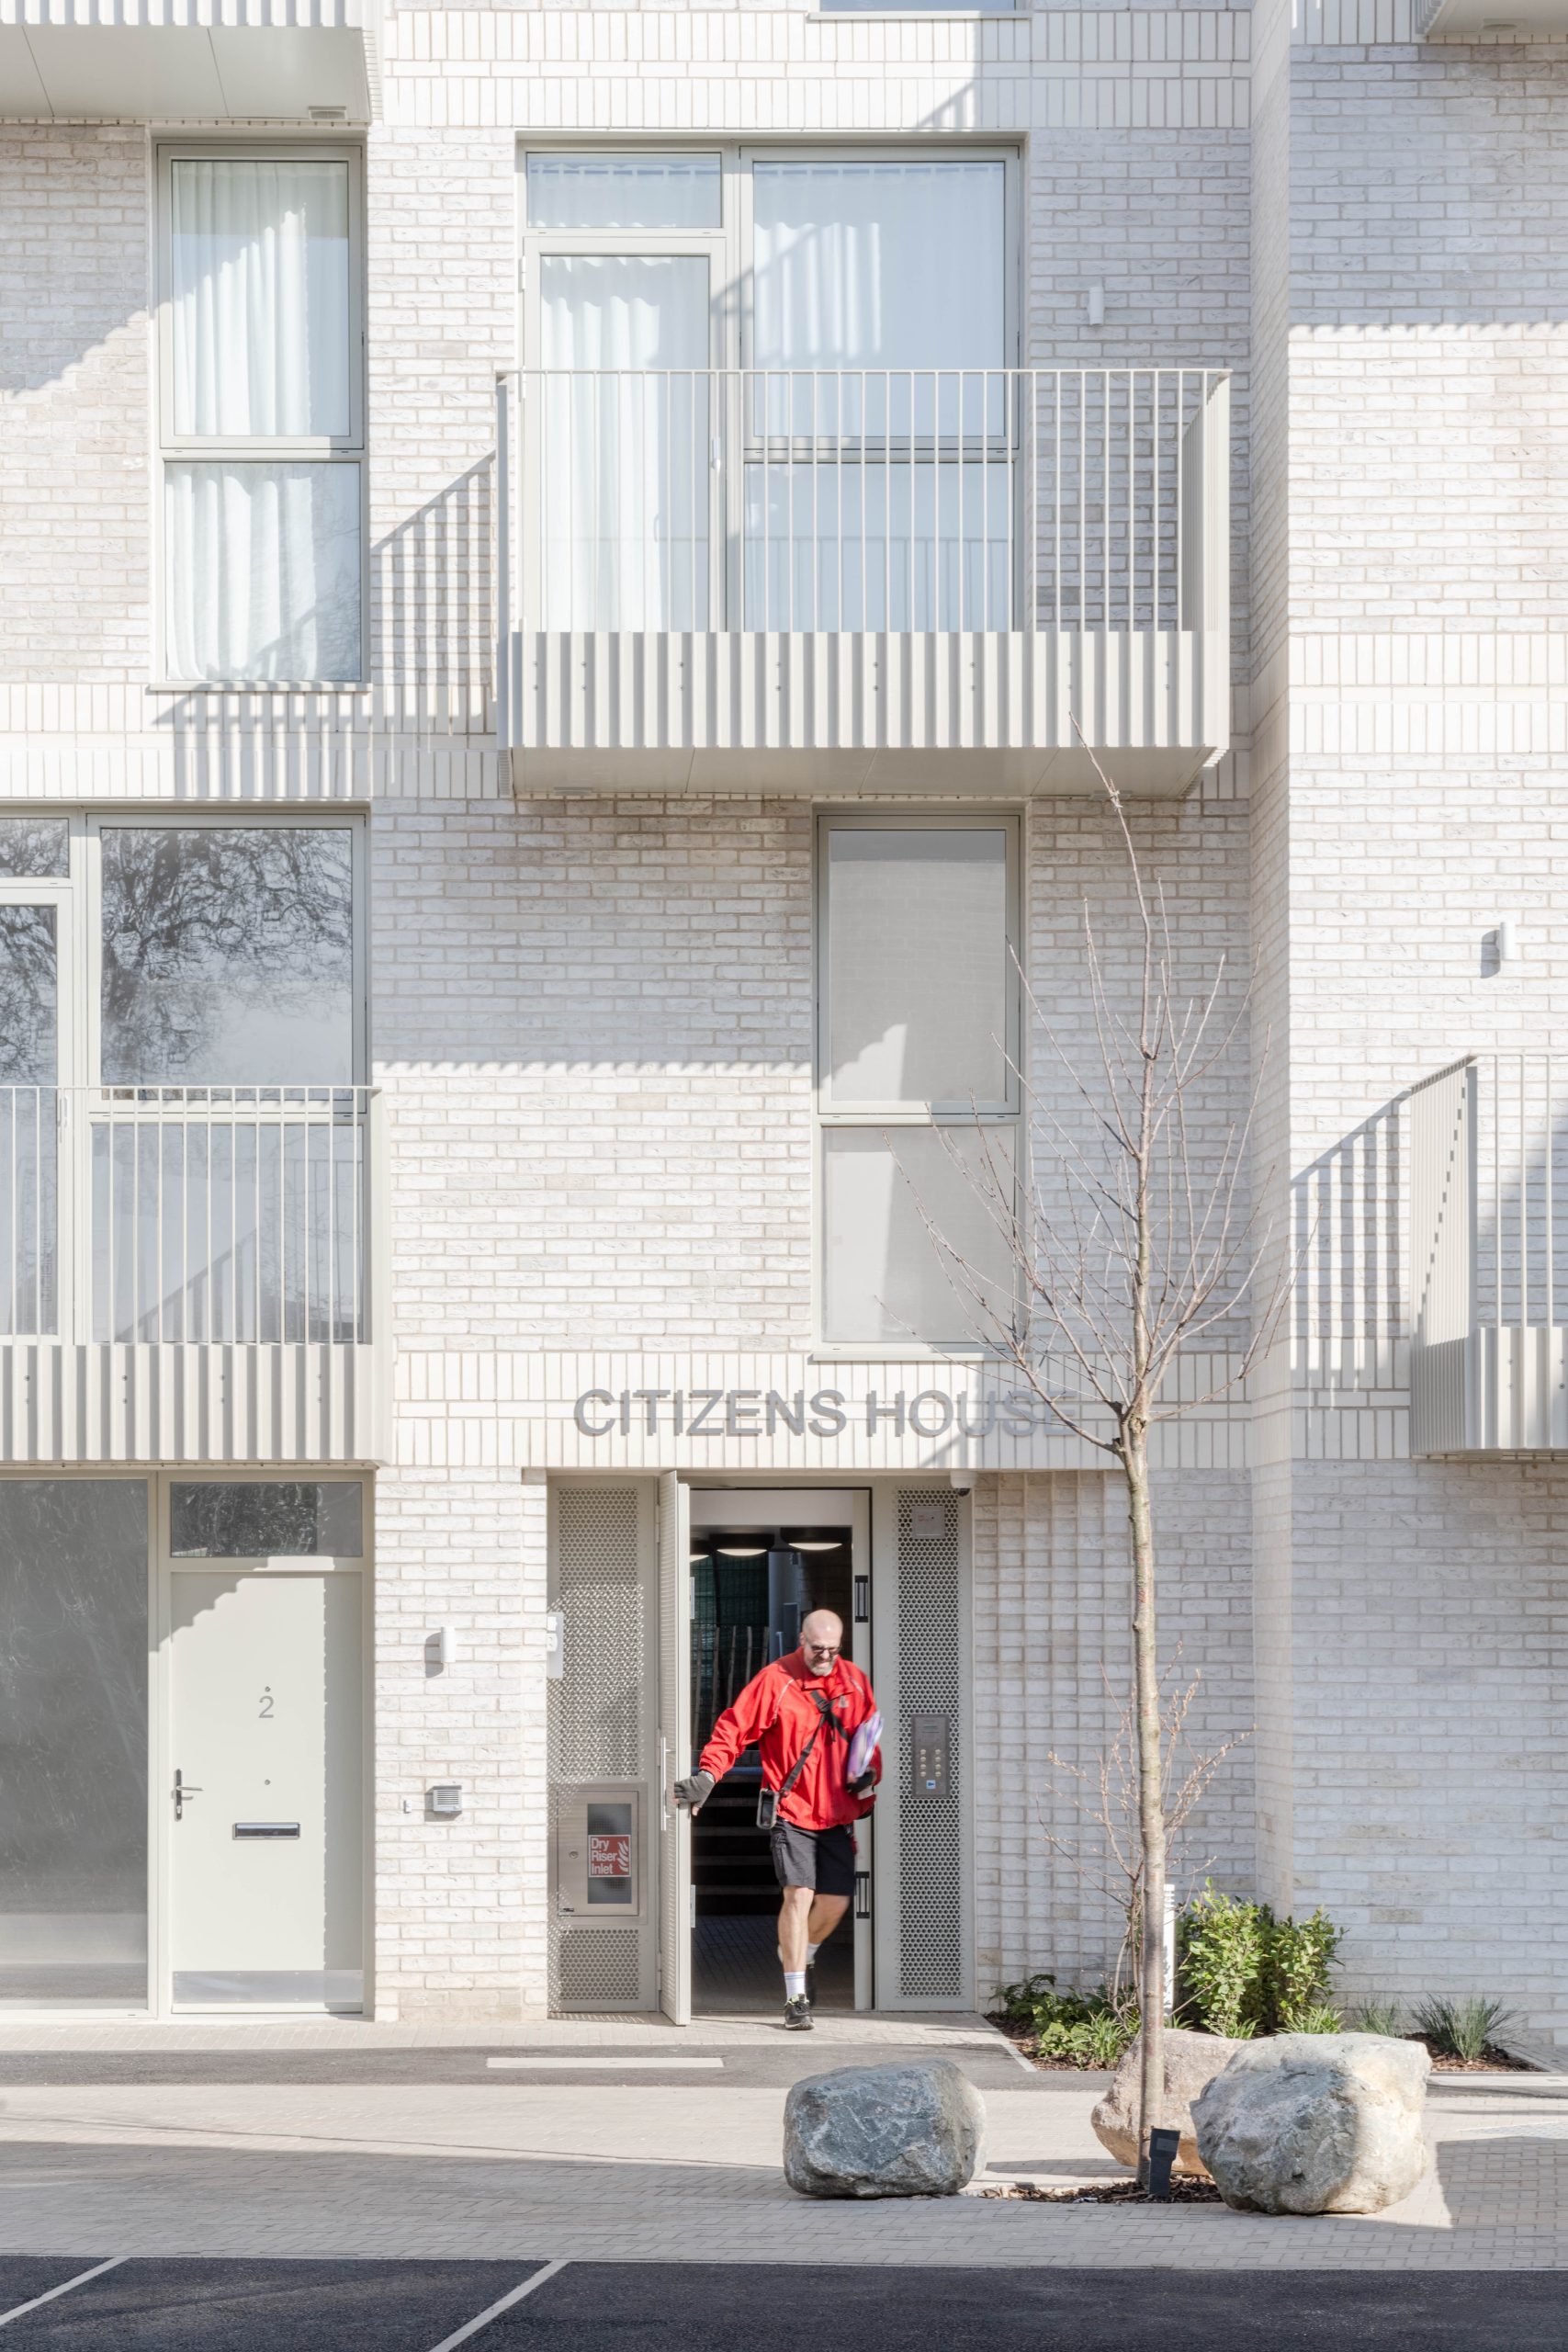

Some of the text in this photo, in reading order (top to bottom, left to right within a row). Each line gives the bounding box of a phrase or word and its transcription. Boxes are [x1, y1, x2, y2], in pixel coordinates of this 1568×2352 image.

[573, 1389, 1077, 1437] CITIZENS HOUSE
[259, 1696, 274, 1718] 2
[591, 1838, 609, 1852] Dry
[591, 1850, 617, 1861] Riser
[591, 1862, 613, 1874] Inlet
